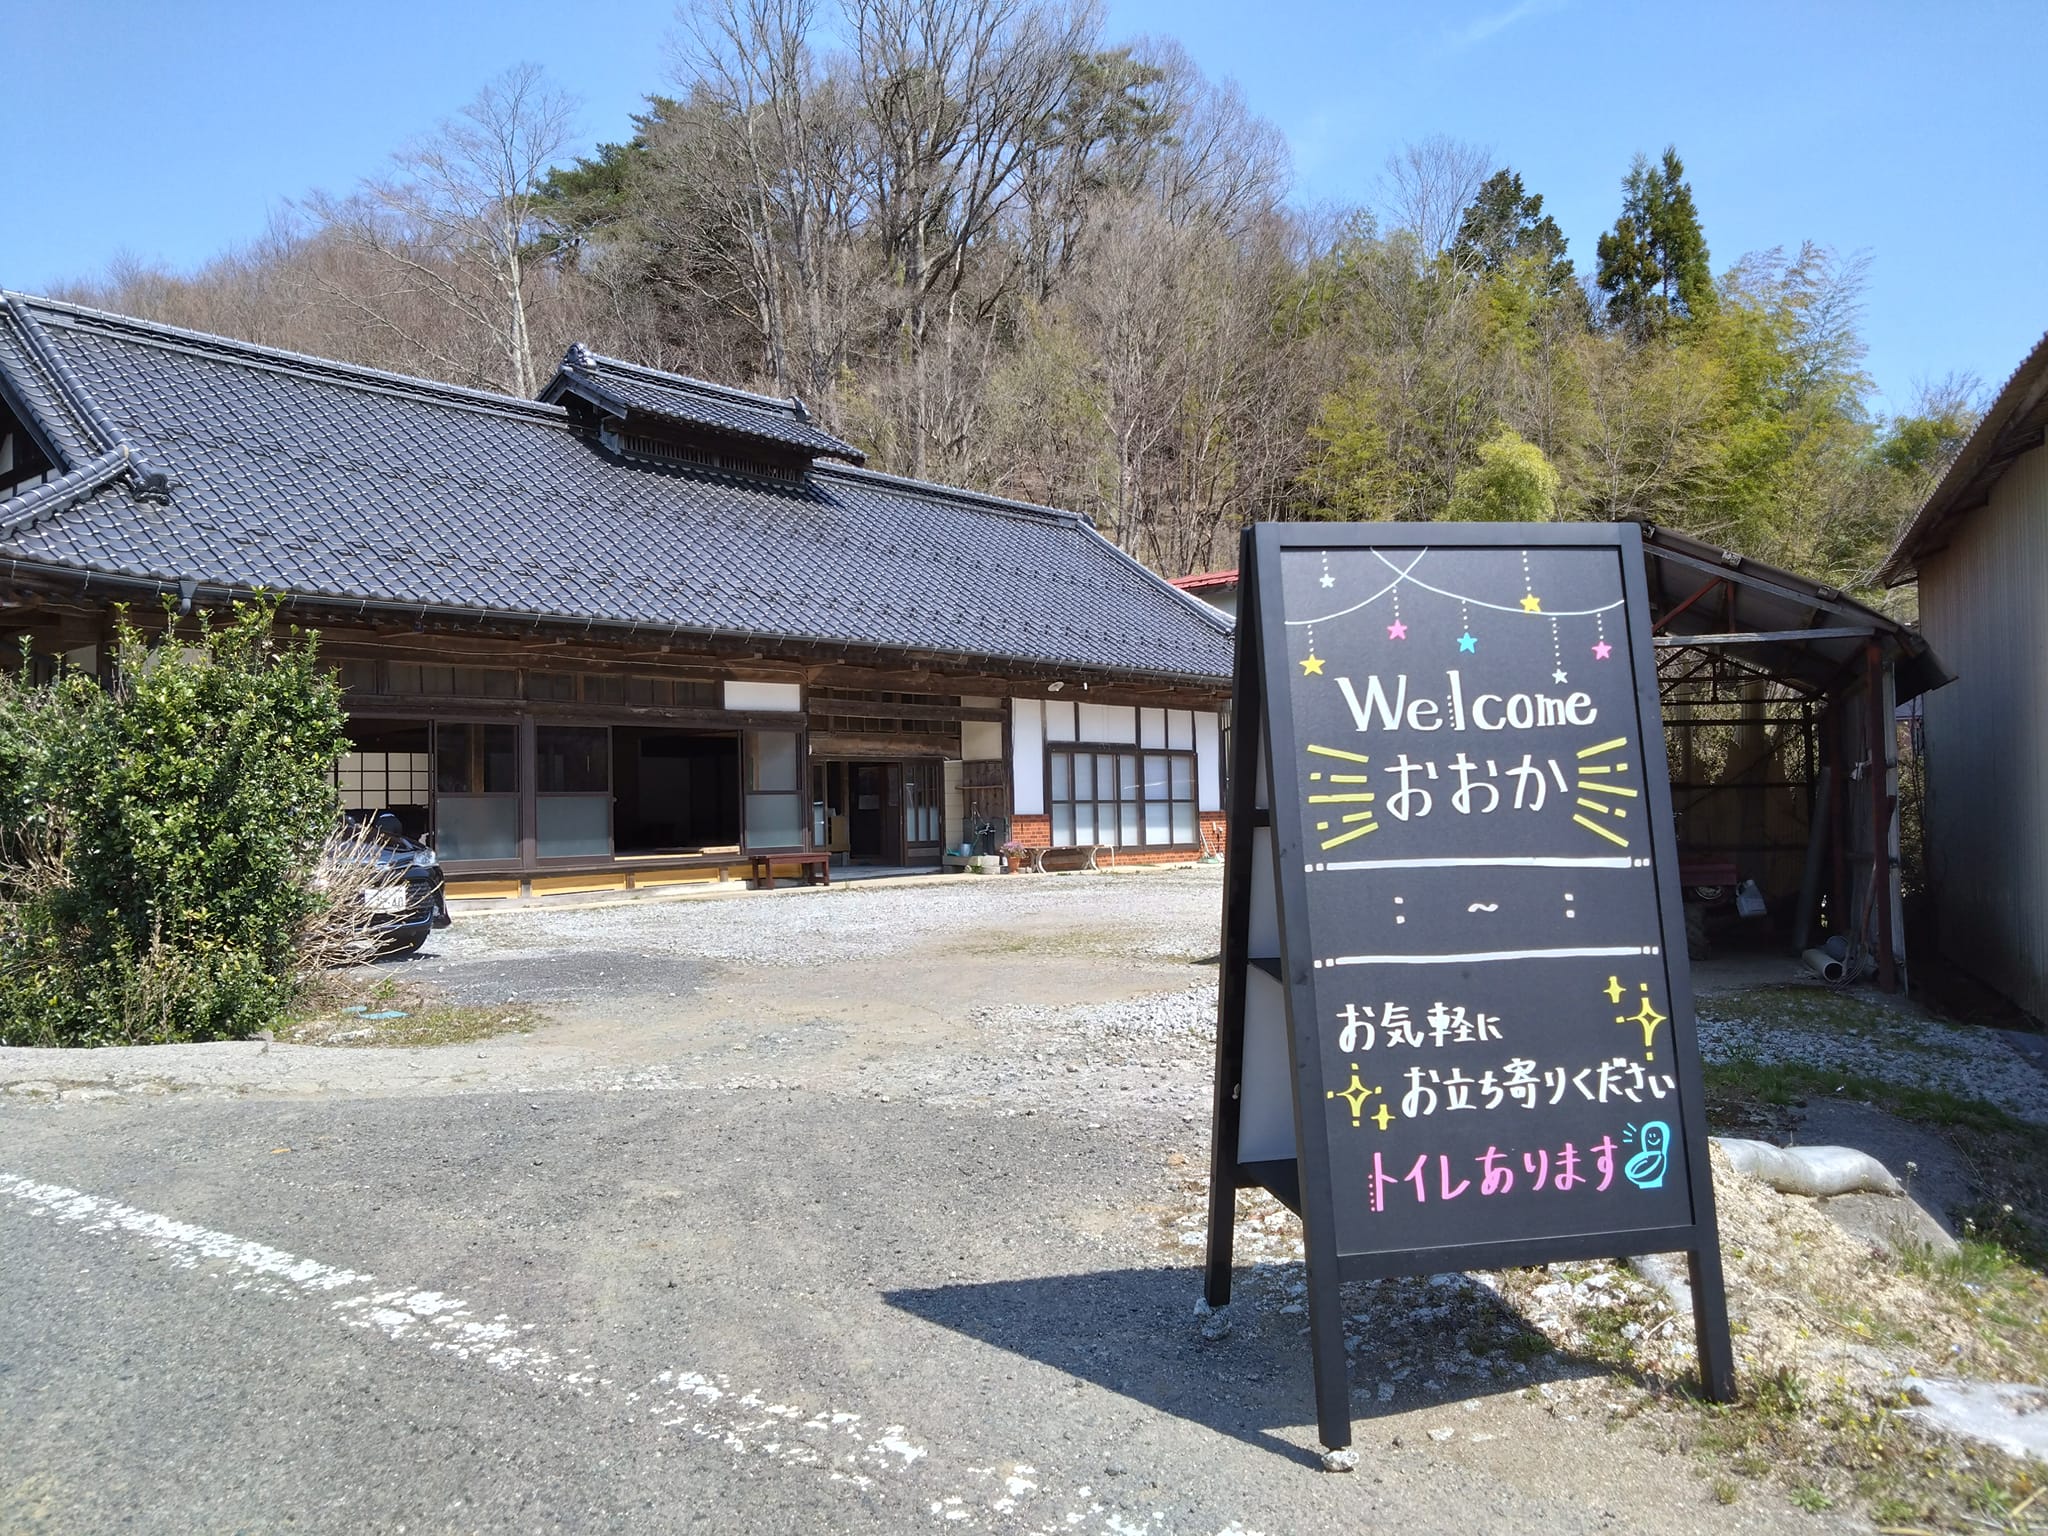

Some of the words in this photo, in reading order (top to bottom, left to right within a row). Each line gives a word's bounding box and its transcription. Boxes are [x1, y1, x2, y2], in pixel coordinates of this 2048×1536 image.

[1333, 668, 1598, 732] Welcome
[1383, 752, 1569, 822] おおか
[1335, 1001, 1504, 1053] お気軽に
[1401, 1057, 1677, 1118] お立ち寄りください
[1369, 1135, 1618, 1212] トイレあります
